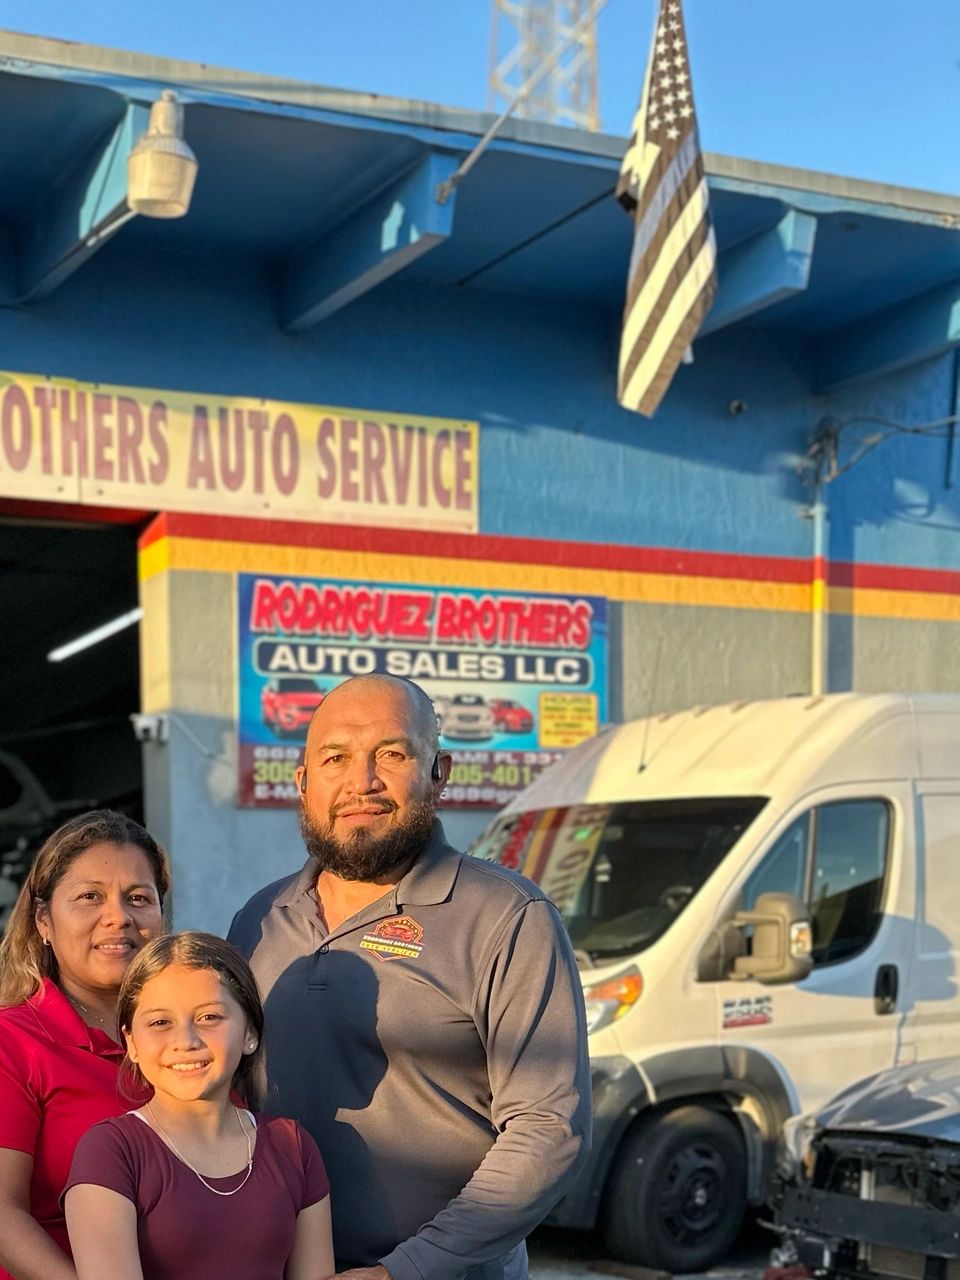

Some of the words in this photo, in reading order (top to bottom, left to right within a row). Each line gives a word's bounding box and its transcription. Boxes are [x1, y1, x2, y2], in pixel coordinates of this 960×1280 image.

[187, 405, 300, 496] AUTO
[318, 418, 473, 511] SERVICE
[250, 580, 433, 639] RODRIGUEZ
[438, 596, 593, 650] BROTHERS
[269, 647, 376, 675] AUTO
[386, 650, 504, 681] SALES
[515, 656, 581, 683] LLC
